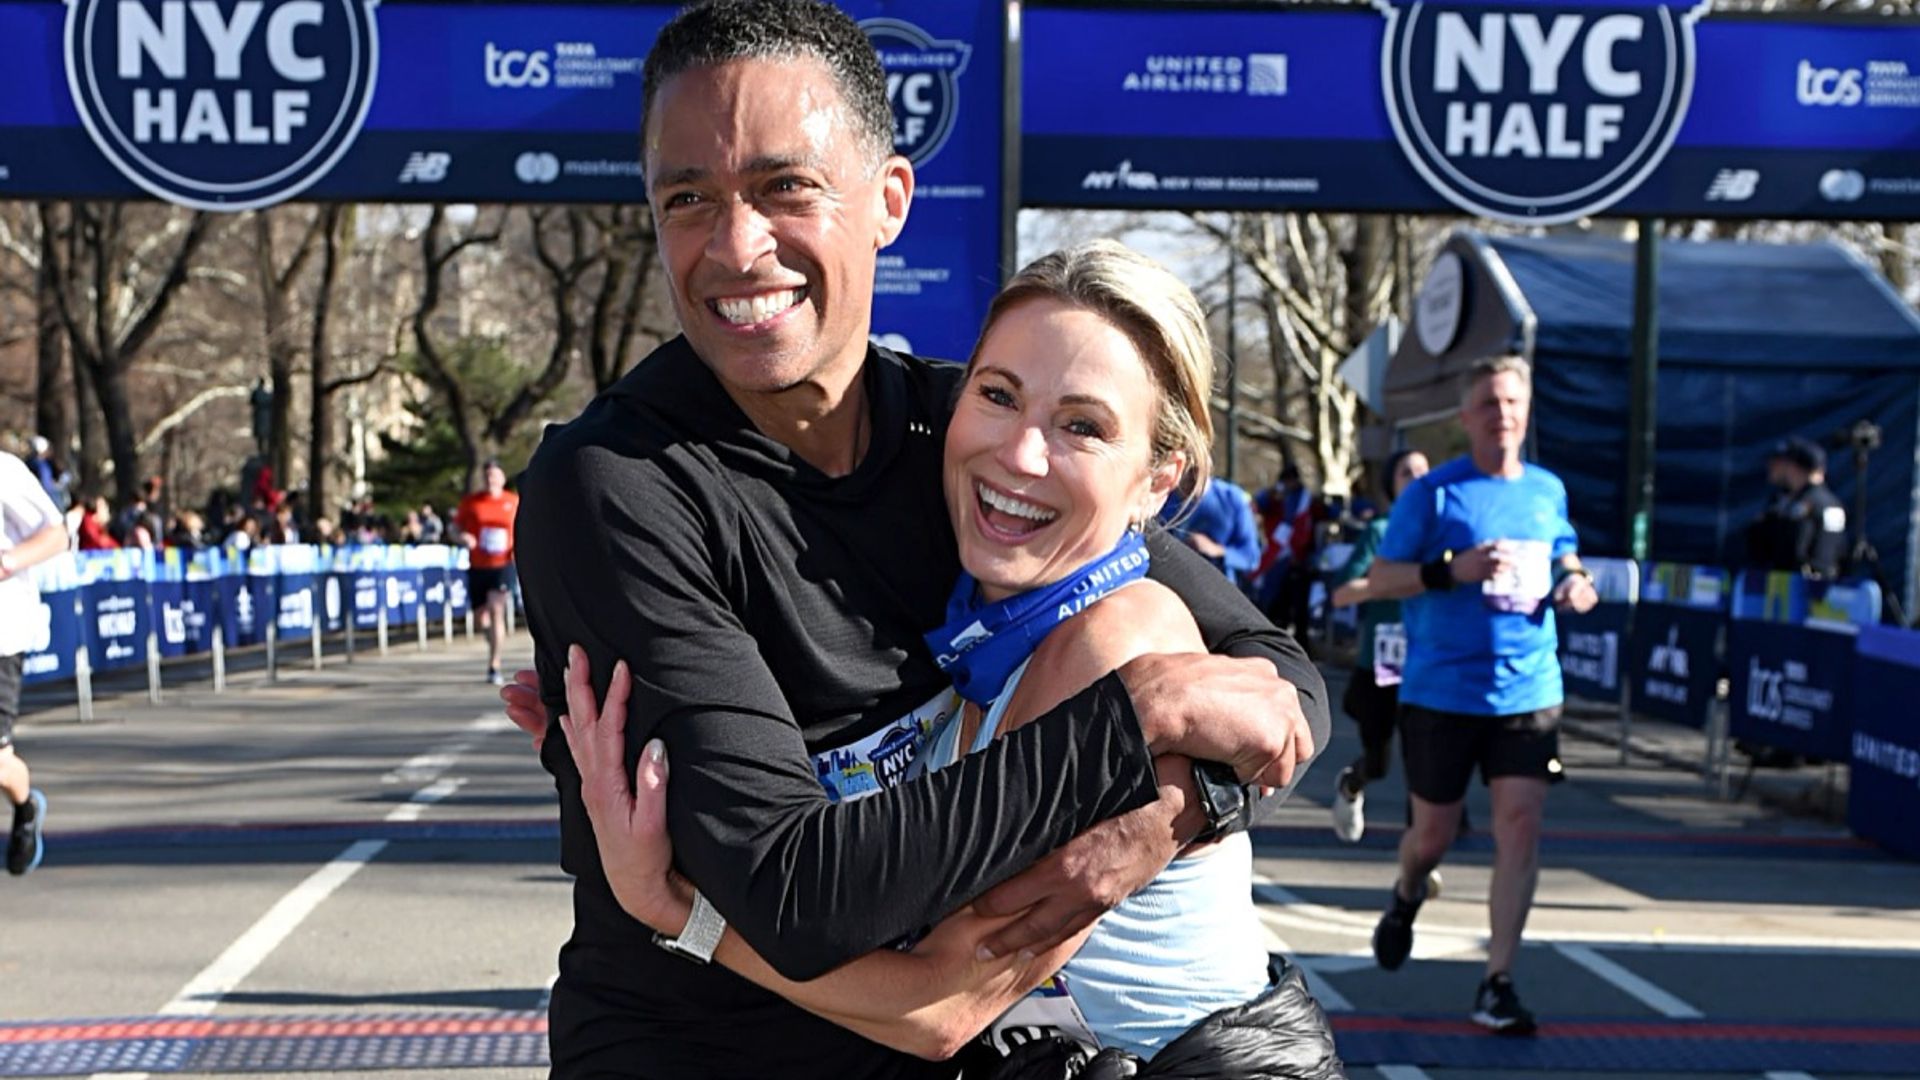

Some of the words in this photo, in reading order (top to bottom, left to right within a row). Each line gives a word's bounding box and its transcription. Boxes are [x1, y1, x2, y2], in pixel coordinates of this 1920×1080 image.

[117, 0, 326, 81] NYC
[1146, 55, 1244, 73] UNITED
[1433, 12, 1644, 97] NYC
[485, 41, 550, 88] tcs
[1122, 72, 1244, 93] AIRLINES
[1796, 58, 1863, 106] tcs
[133, 88, 310, 144] HALF
[1445, 101, 1625, 159] HALF
[1073, 552, 1143, 595] UNITED
[883, 743, 915, 776] NYC
